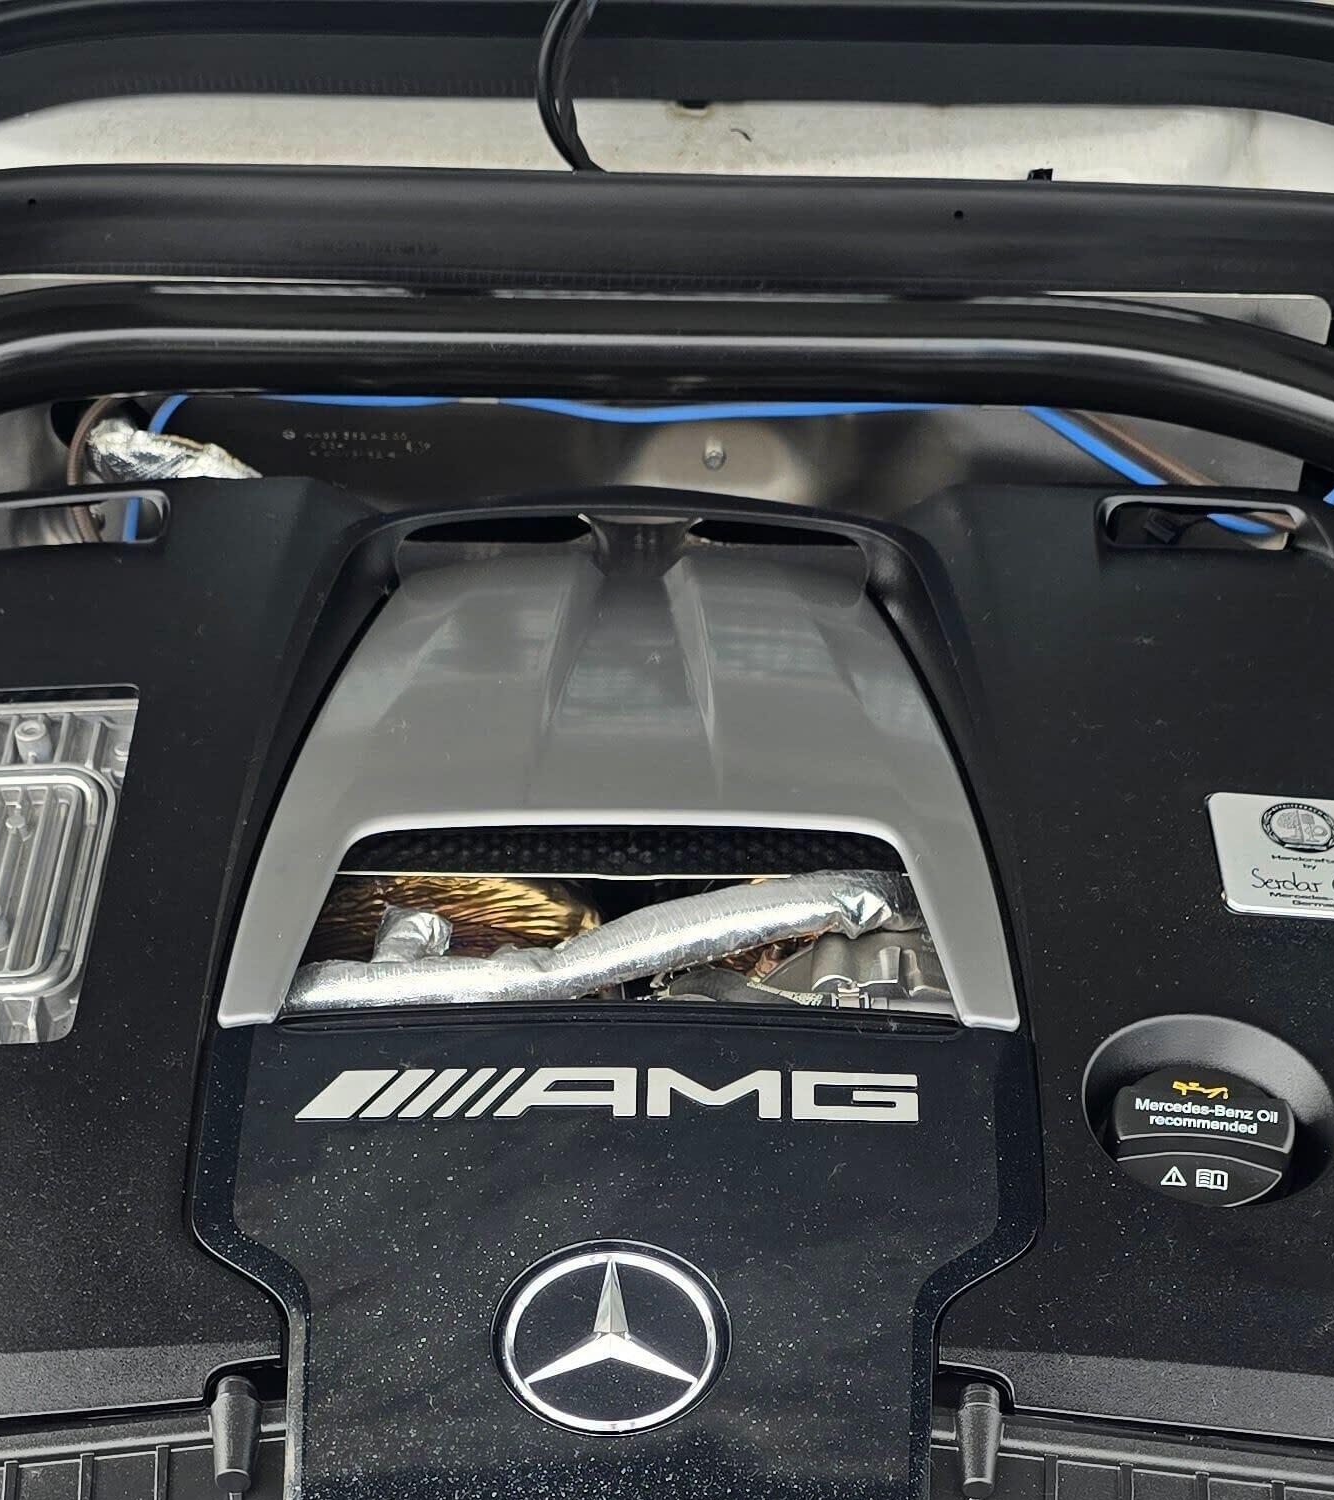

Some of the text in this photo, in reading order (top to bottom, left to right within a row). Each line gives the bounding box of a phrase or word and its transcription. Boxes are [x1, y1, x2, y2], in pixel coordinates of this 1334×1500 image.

[1302, 863, 1317, 871] by
[493, 1067, 919, 1122] AMG
[1135, 1098, 1279, 1124] Mercedes-Benz Oil
[1149, 1114, 1258, 1135] recommended
